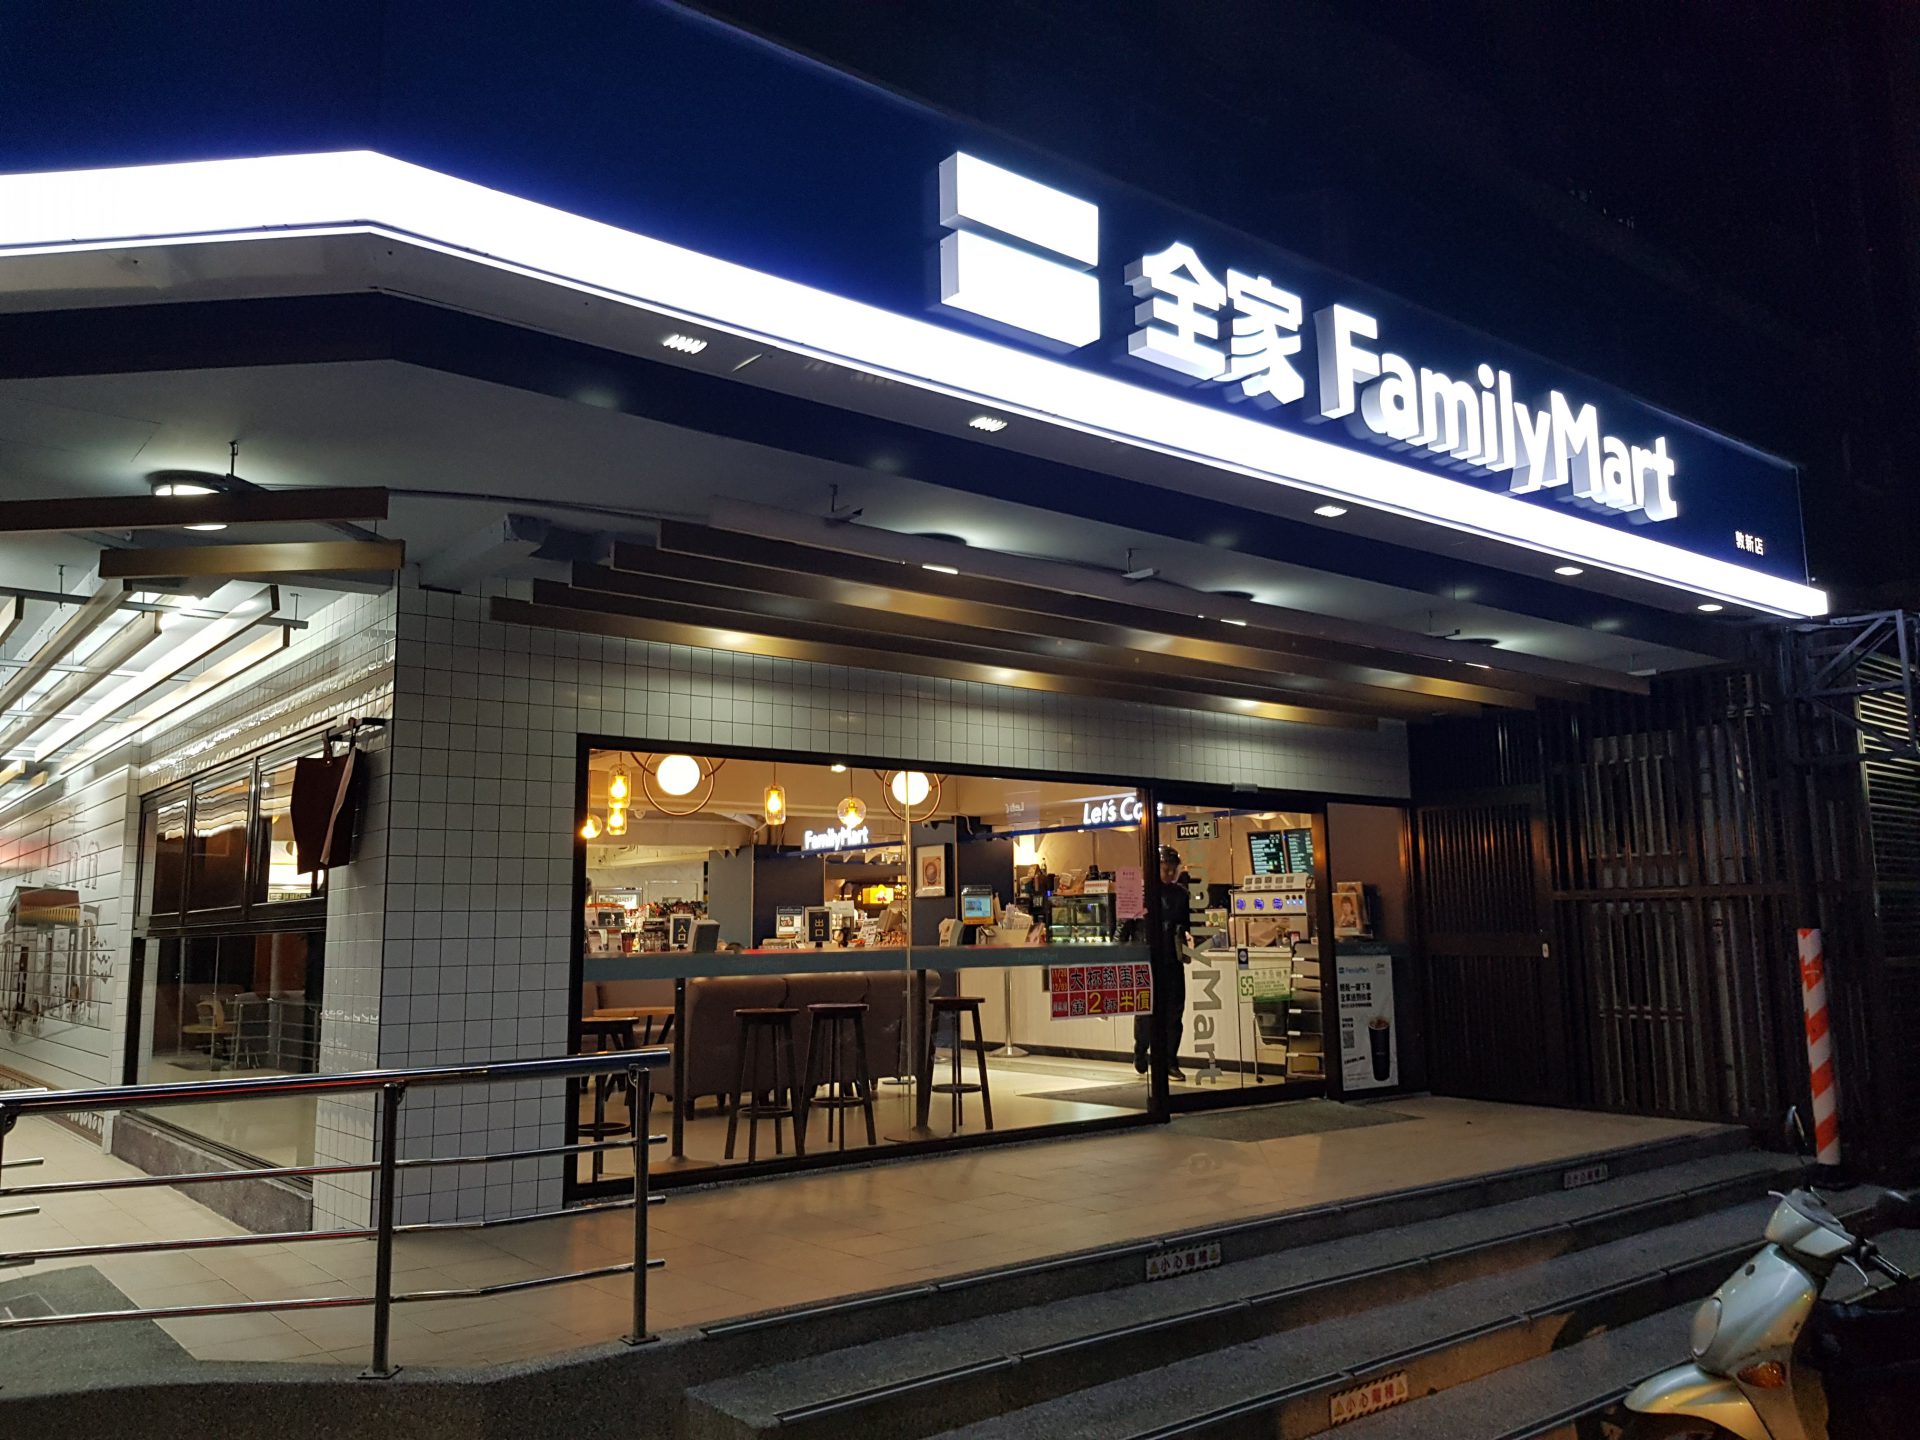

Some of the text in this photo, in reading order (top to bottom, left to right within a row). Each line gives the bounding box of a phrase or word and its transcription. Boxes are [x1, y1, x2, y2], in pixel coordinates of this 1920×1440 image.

[1125, 242, 1304, 404] 全家
[1317, 303, 1678, 522] FamilyMart
[1083, 800, 1117, 825] Let's
[804, 825, 869, 851] FamilyMart
[678, 925, 687, 941] 入口
[815, 919, 824, 937] 出口
[1069, 964, 1150, 990] 大杯熱美式
[1072, 990, 1150, 1015] 第2杯半價
